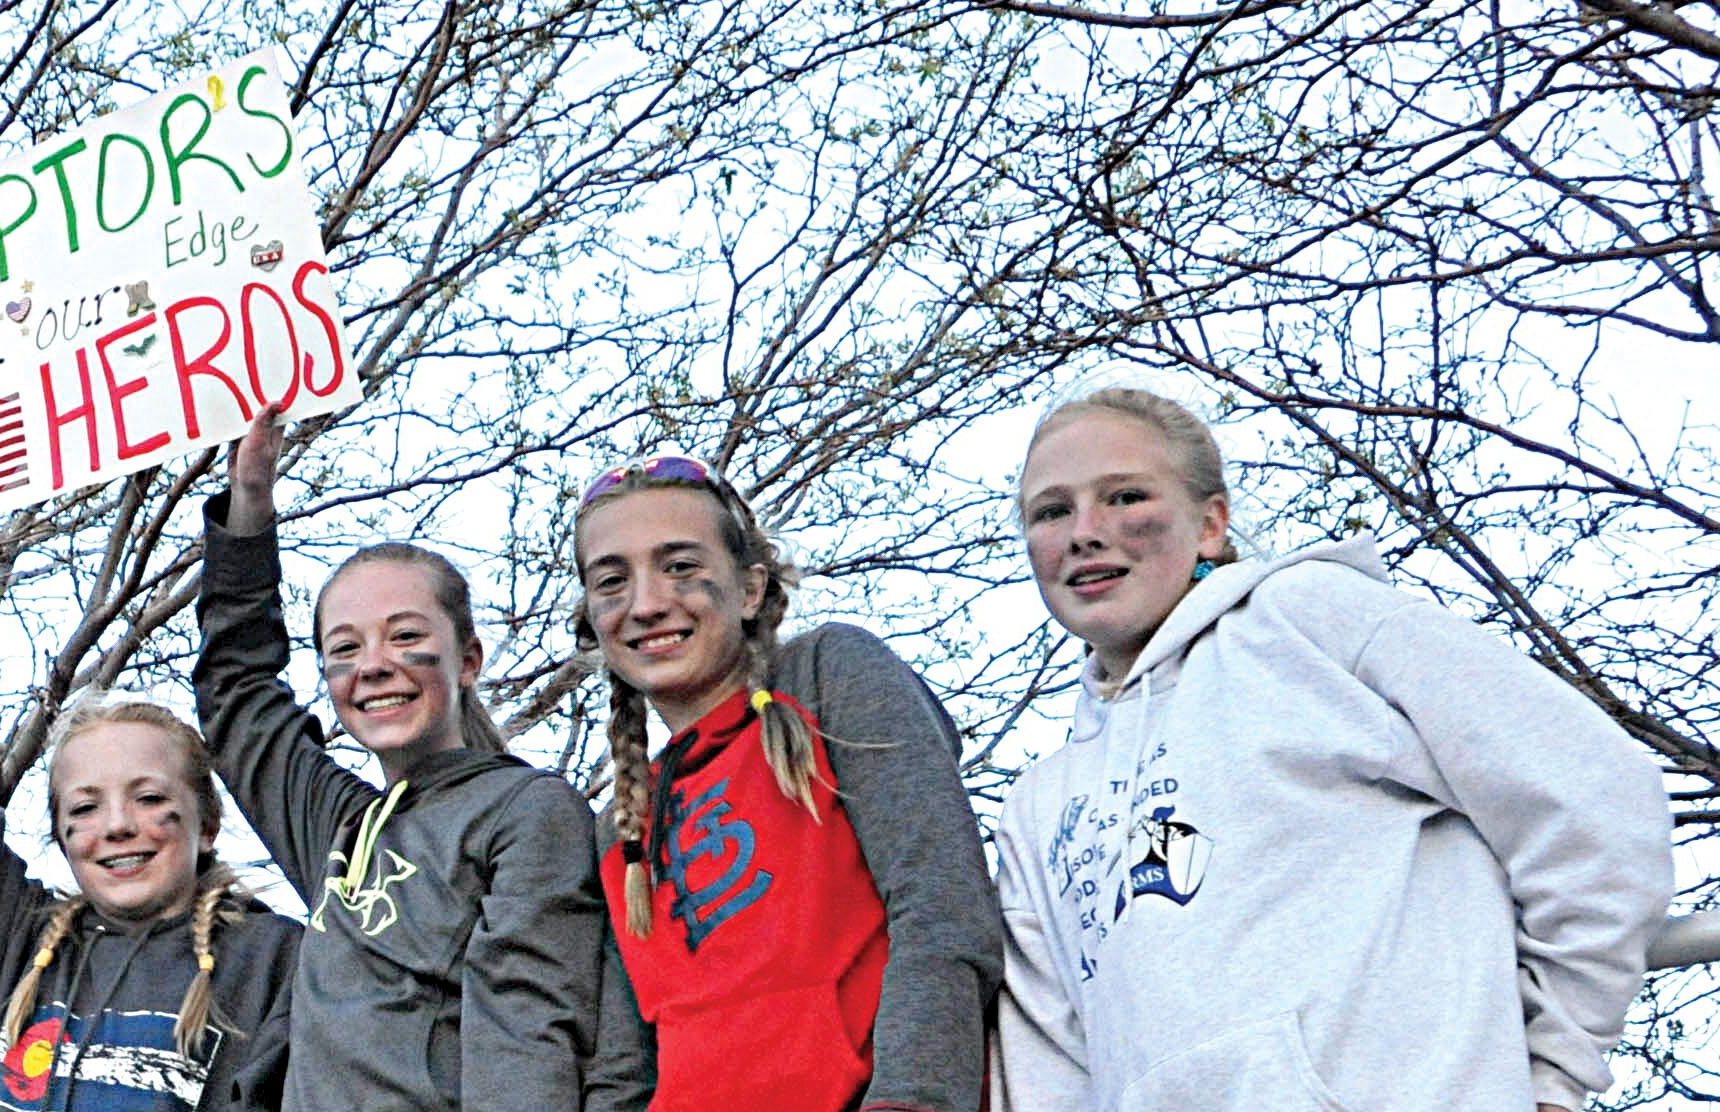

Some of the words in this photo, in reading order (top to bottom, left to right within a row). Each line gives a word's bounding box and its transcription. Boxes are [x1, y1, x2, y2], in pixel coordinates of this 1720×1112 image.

[164, 210, 260, 269] Edge
[35, 286, 122, 352] our
[39, 259, 345, 491] HEROS
